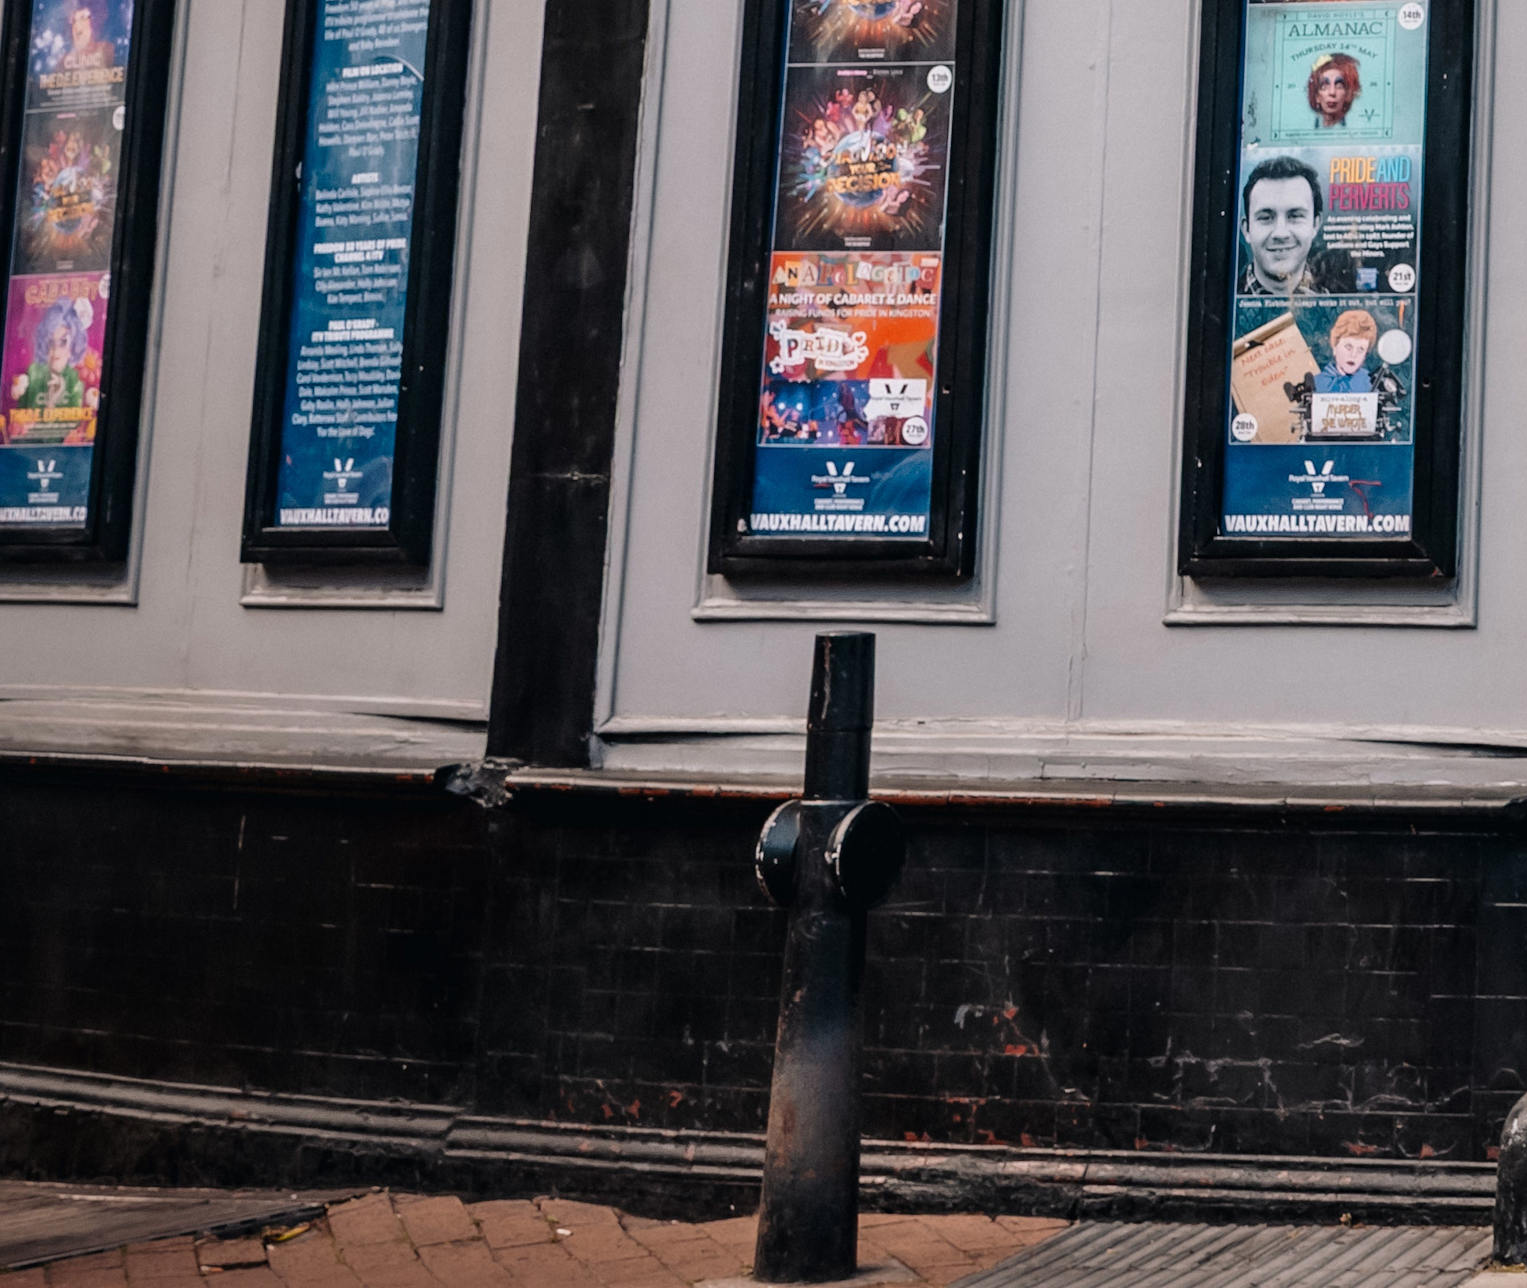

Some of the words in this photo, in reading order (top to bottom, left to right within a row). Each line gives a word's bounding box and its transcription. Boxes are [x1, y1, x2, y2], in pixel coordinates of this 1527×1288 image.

[1288, 22, 1383, 37] ALMANAC
[1290, 43, 1337, 62] THURSDAY
[1329, 157, 1376, 184] PRIDE
[1376, 155, 1412, 183] AND
[1328, 182, 1410, 211] PERVERTS
[1392, 272, 1412, 281] 21st
[779, 294, 815, 305] NIGHT
[816, 294, 832, 305] OF
[832, 294, 883, 306] CABARET
[895, 294, 937, 305] DANCE
[750, 514, 926, 533] VAUXHALLTAVERN.COM
[1224, 515, 1410, 533] VAUXHALLTAVERN.COM
